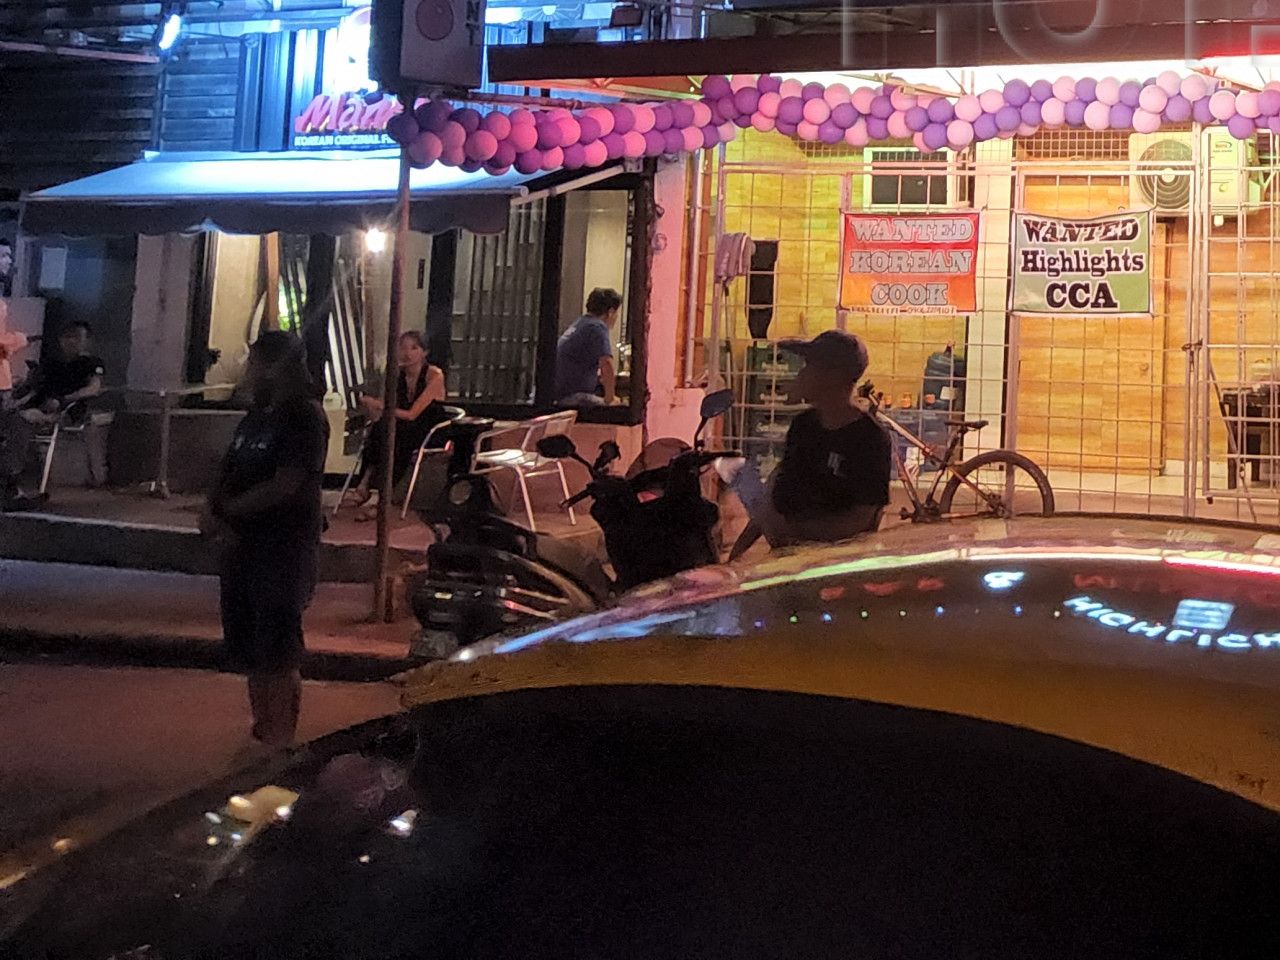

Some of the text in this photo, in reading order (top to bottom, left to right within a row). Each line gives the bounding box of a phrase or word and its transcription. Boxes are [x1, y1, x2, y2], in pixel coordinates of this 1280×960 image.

[850, 218, 973, 243] WANTED
[1021, 218, 1140, 244] WANTED
[849, 250, 972, 274] KOREAN
[1020, 249, 1145, 278] Highlights
[871, 283, 949, 306] COOK
[1045, 283, 1118, 310] CCA
